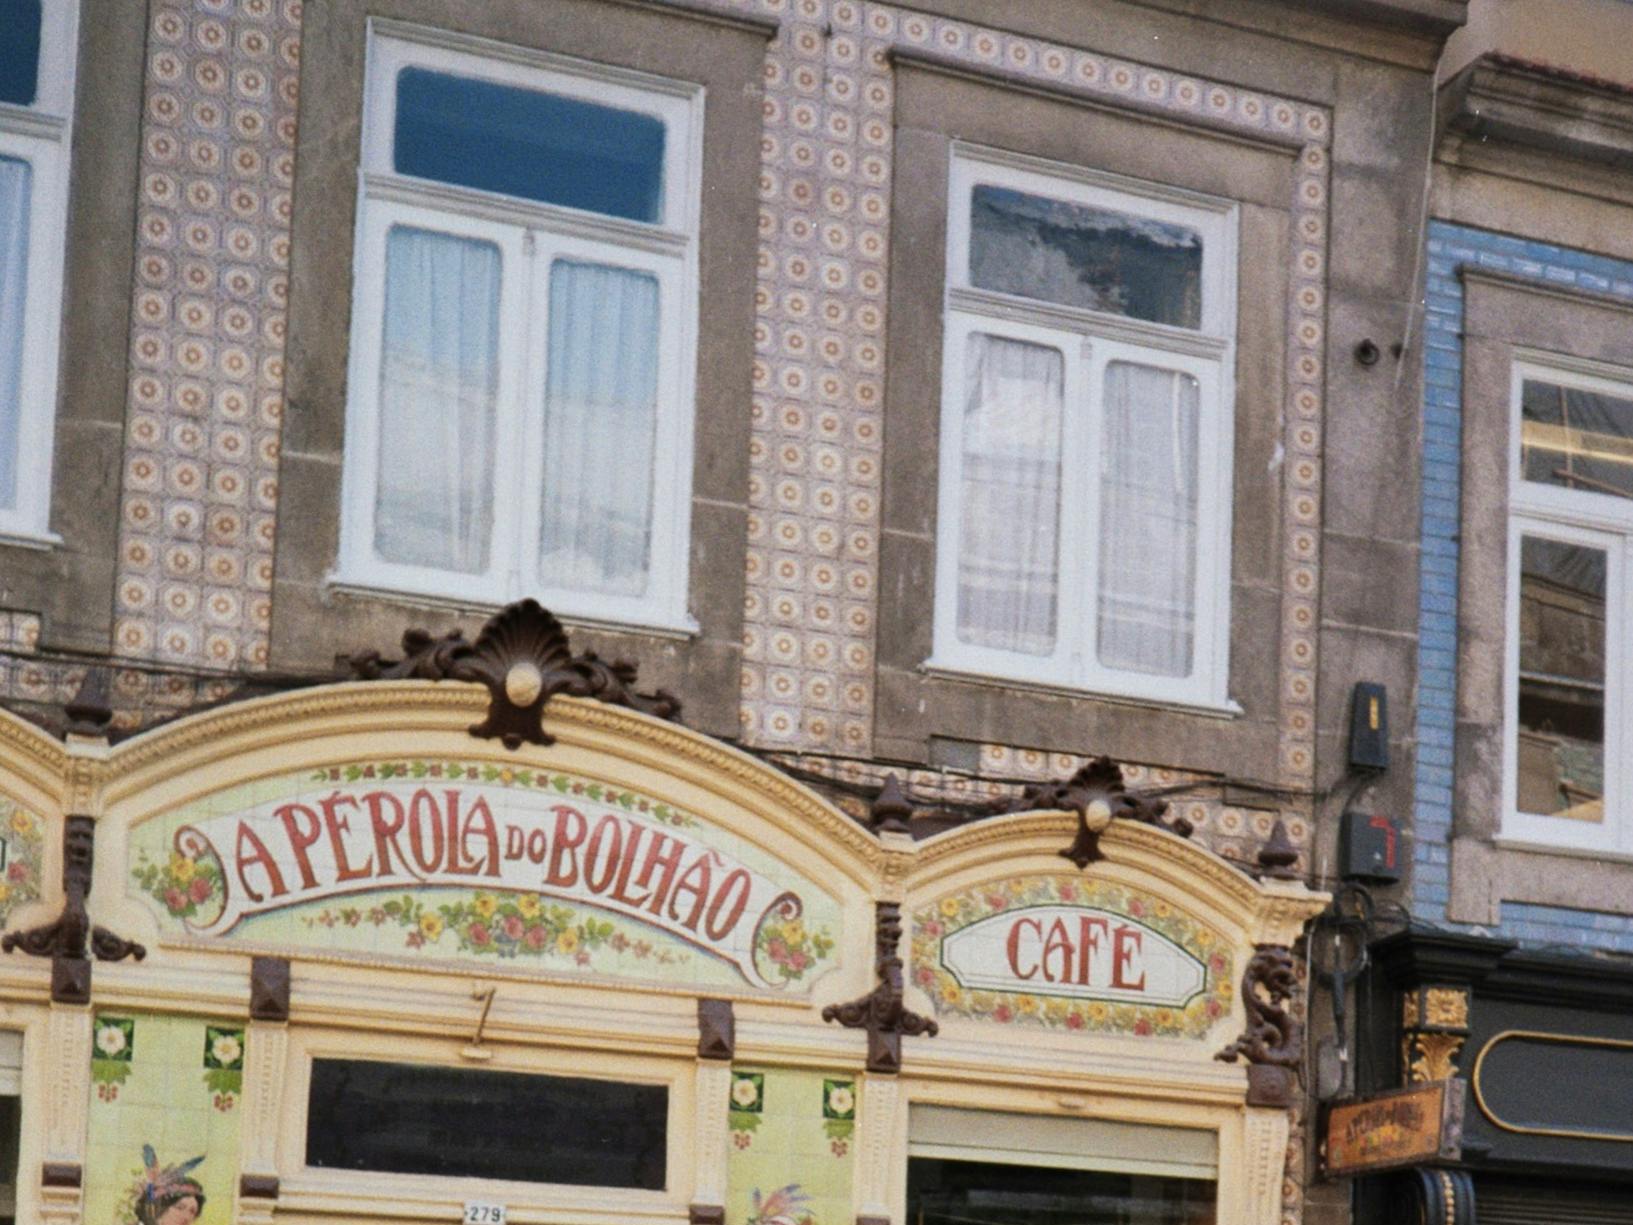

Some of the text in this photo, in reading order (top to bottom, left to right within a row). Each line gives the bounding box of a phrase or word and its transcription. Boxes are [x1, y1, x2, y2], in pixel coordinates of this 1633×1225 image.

[235, 788, 752, 943] A PÉROLA DO BOLHÃO
[1006, 916, 1146, 992] CAFÉ
[470, 1206, 501, 1222] 279
